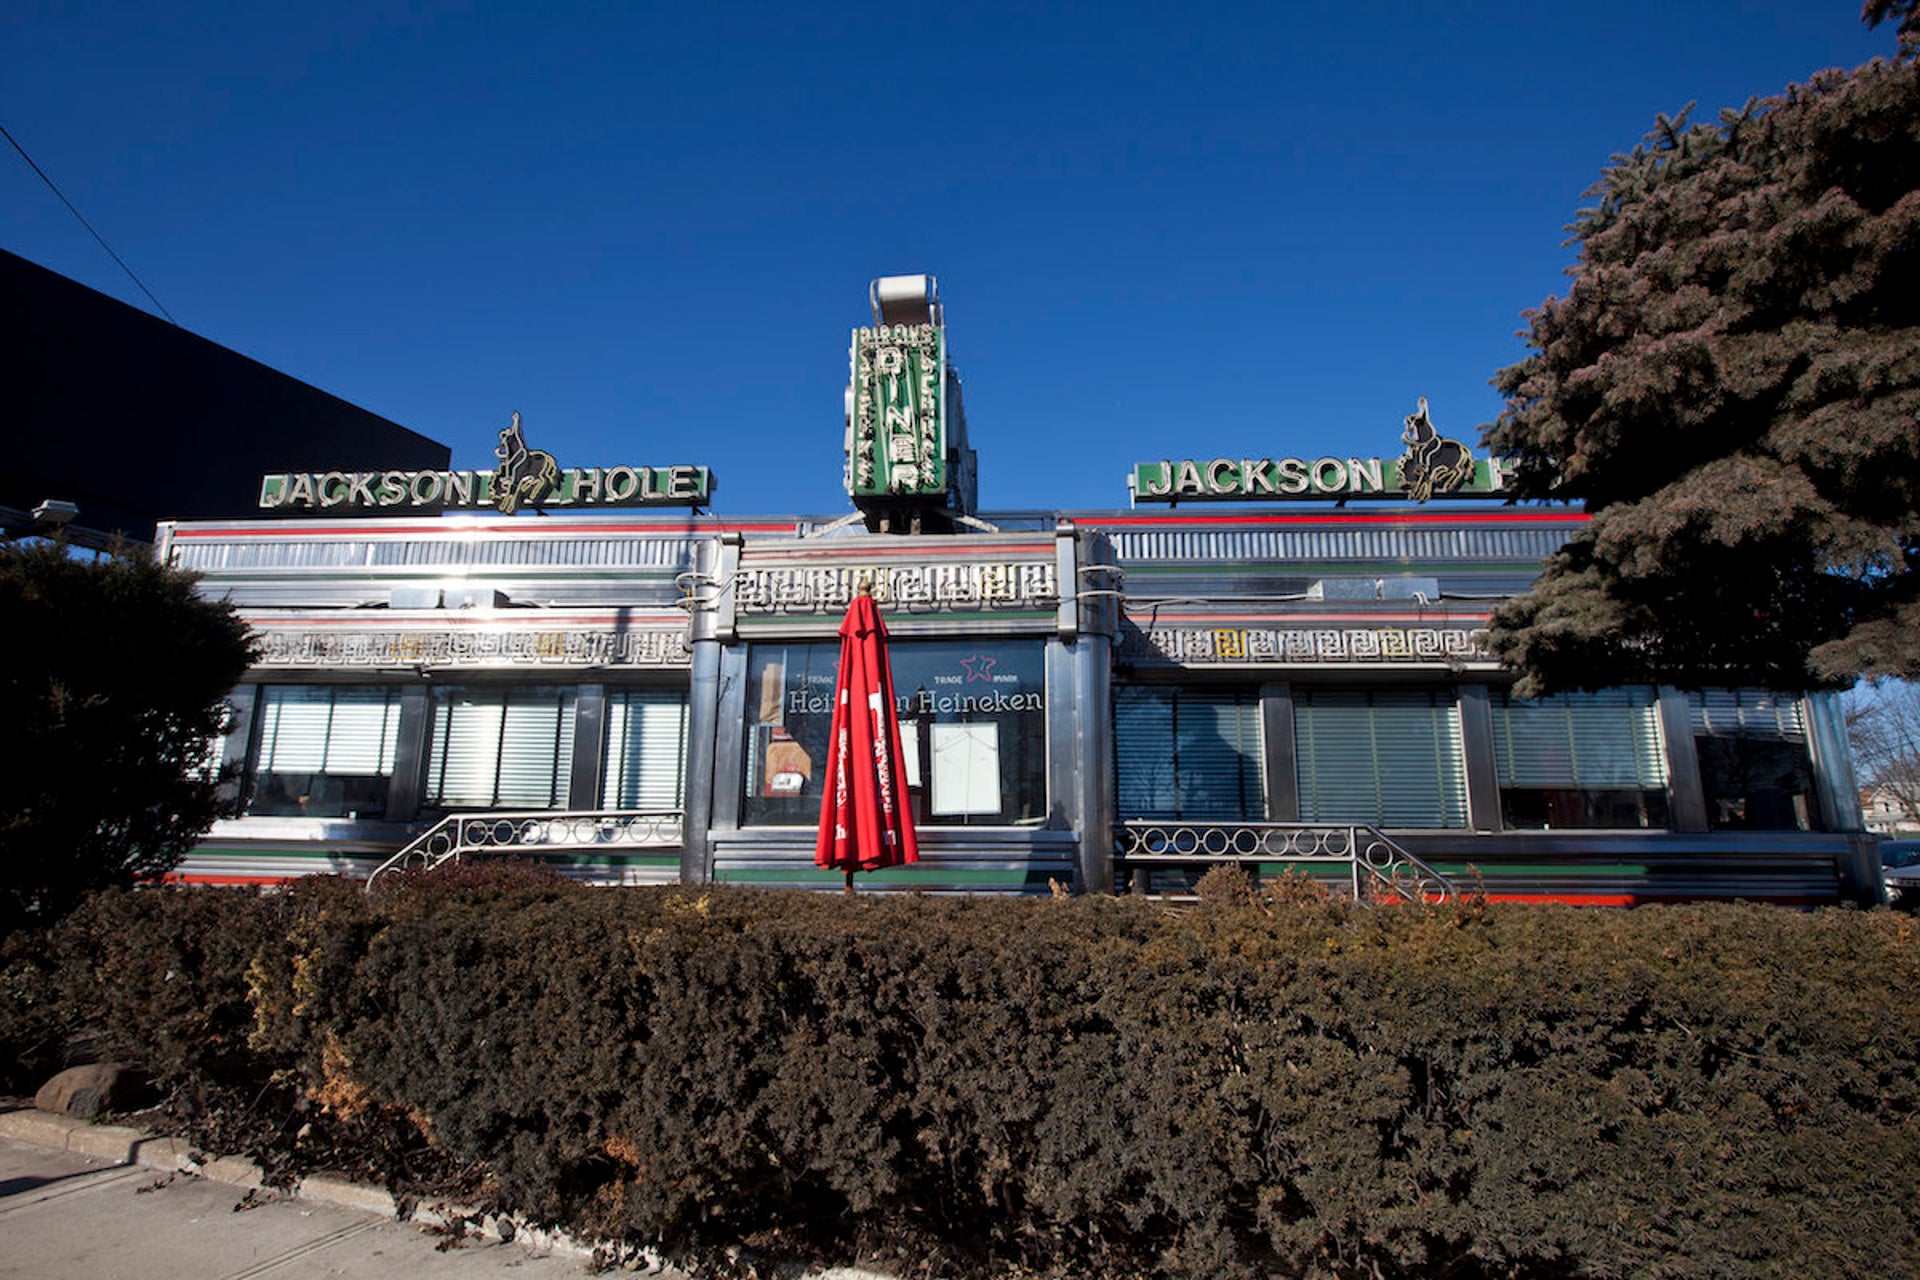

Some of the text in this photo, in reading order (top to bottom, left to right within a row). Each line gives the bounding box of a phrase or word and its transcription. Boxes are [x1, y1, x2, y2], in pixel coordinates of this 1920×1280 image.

[877, 347, 918, 492] DINER
[265, 465, 701, 506] JACKSON HOLE
[1148, 456, 1384, 495] JACKSON
[918, 689, 1043, 713] Heineken
